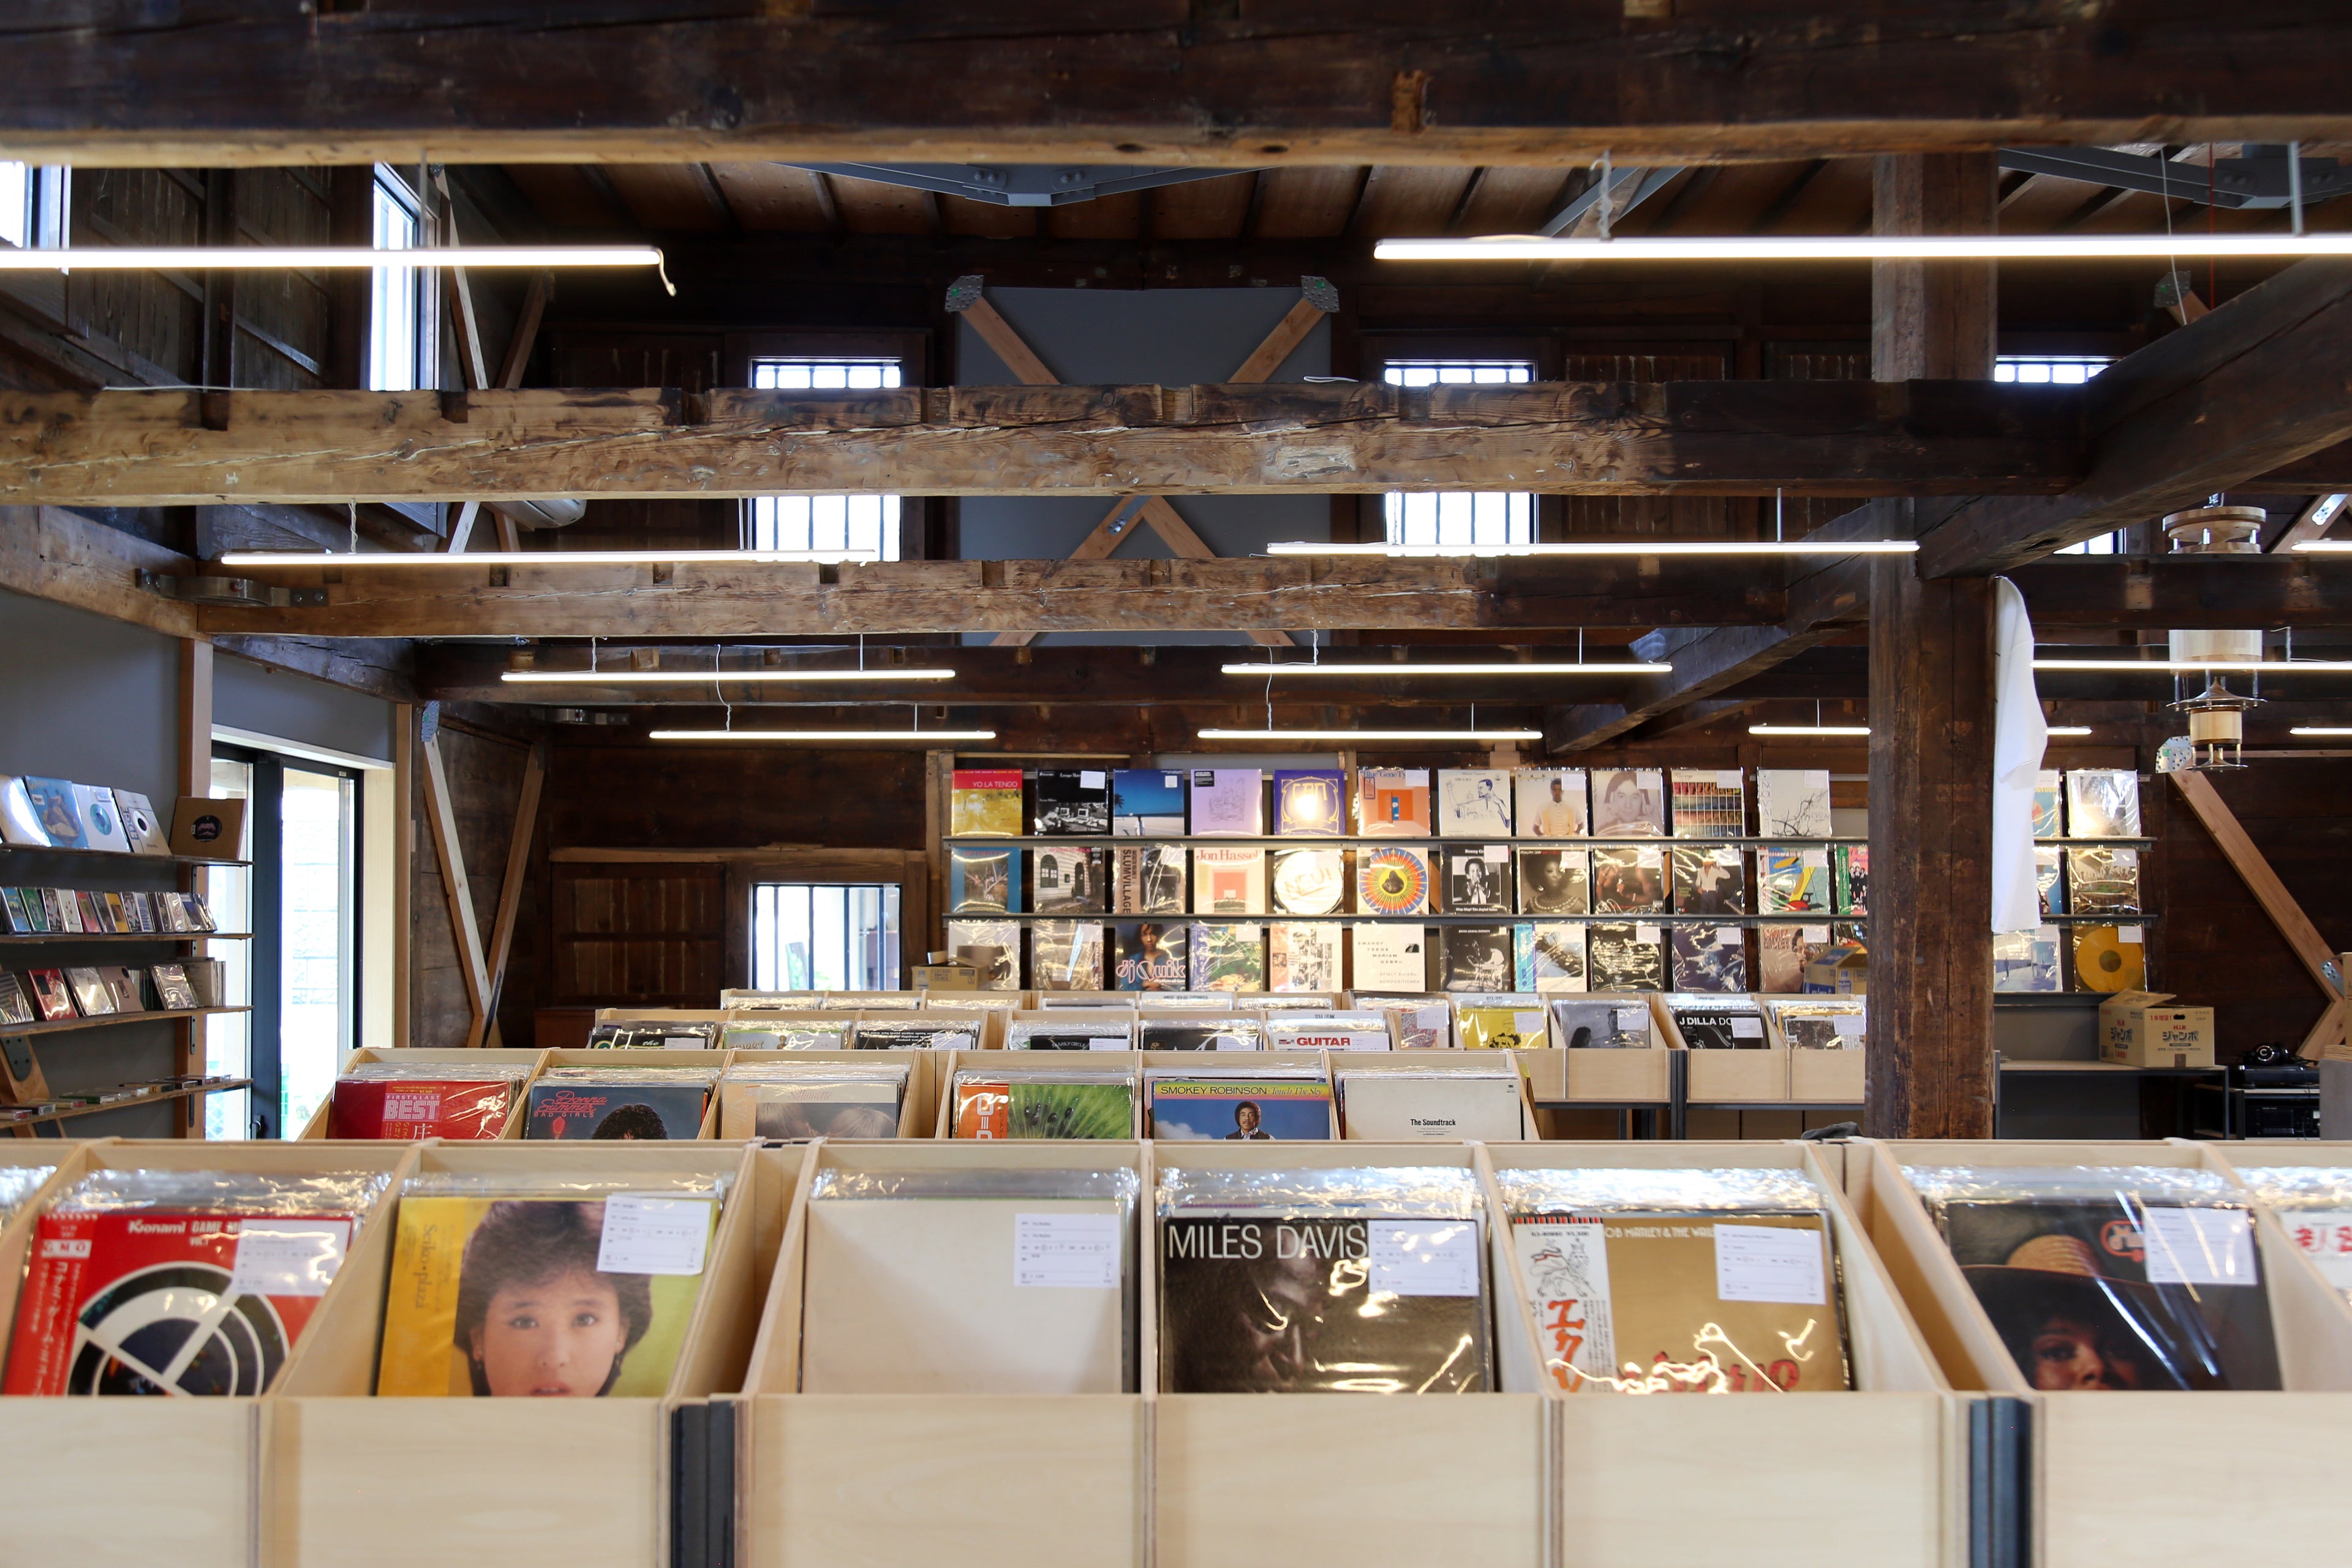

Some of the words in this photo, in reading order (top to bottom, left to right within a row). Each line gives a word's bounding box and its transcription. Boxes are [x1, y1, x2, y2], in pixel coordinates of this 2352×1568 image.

[1196, 850, 1218, 861] Jon
[1116, 959, 1135, 984] dj
[1136, 959, 1186, 981] Quik
[1297, 1037, 1351, 1046] GUITAR
[2111, 1027, 2133, 1043] ジャンボ
[2162, 1031, 2199, 1041] ジャンボ
[556, 1090, 608, 1105] Donna
[1161, 1087, 1207, 1095] SMOKEY
[1210, 1087, 1267, 1095] ROBINSON
[1271, 1087, 1292, 1096] Touch
[1294, 1087, 1308, 1095] The
[1310, 1087, 1322, 1098] Sky
[384, 1100, 440, 1120] BEST
[537, 1098, 597, 1114] Summer
[127, 1219, 187, 1234] Konami
[191, 1221, 223, 1234] GAME
[1605, 1227, 1623, 1238] OB
[1627, 1227, 1663, 1238] MARLEY
[1672, 1227, 1689, 1238] THE
[1691, 1227, 1715, 1238] WAIL
[1168, 1224, 1263, 1259] MILES
[1276, 1224, 1369, 1260] DAVIS
